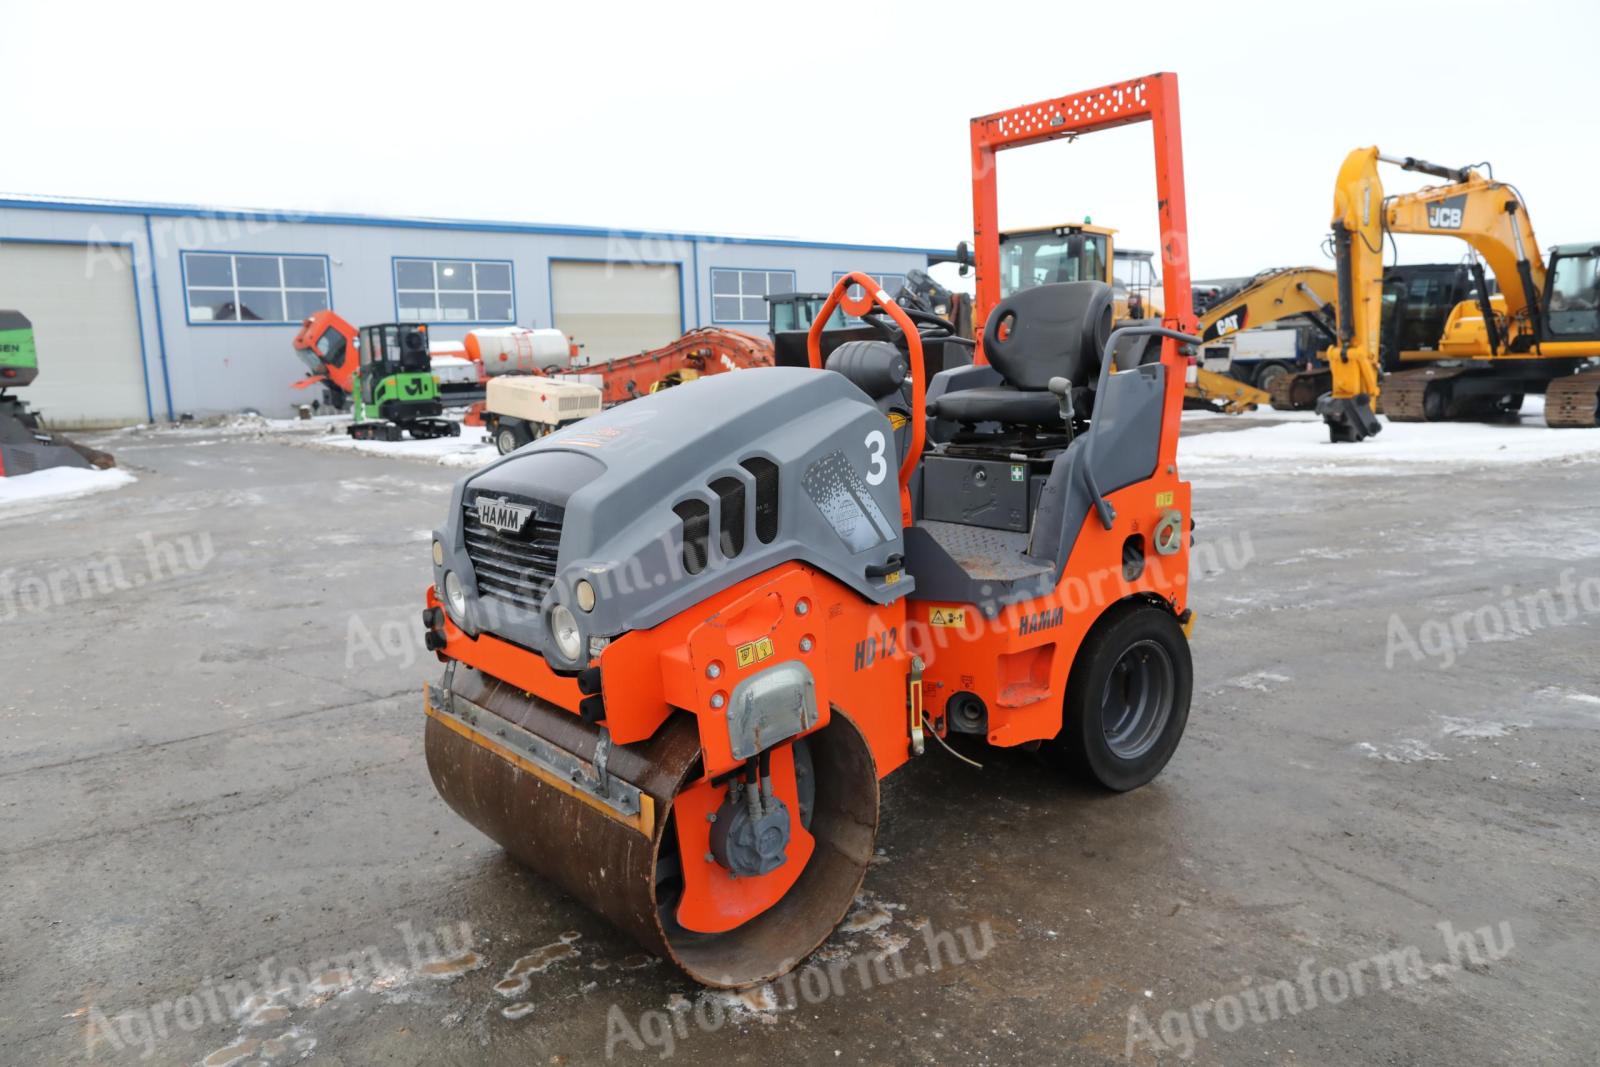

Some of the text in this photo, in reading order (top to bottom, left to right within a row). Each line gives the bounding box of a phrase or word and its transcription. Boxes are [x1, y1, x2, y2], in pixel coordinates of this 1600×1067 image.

[1429, 207, 1461, 228] JCB
[1216, 314, 1239, 336] CAT
[864, 430, 888, 486] 3
[481, 504, 519, 529] HAMM
[1019, 606, 1064, 637] HAMM
[854, 626, 897, 672] HD 12
